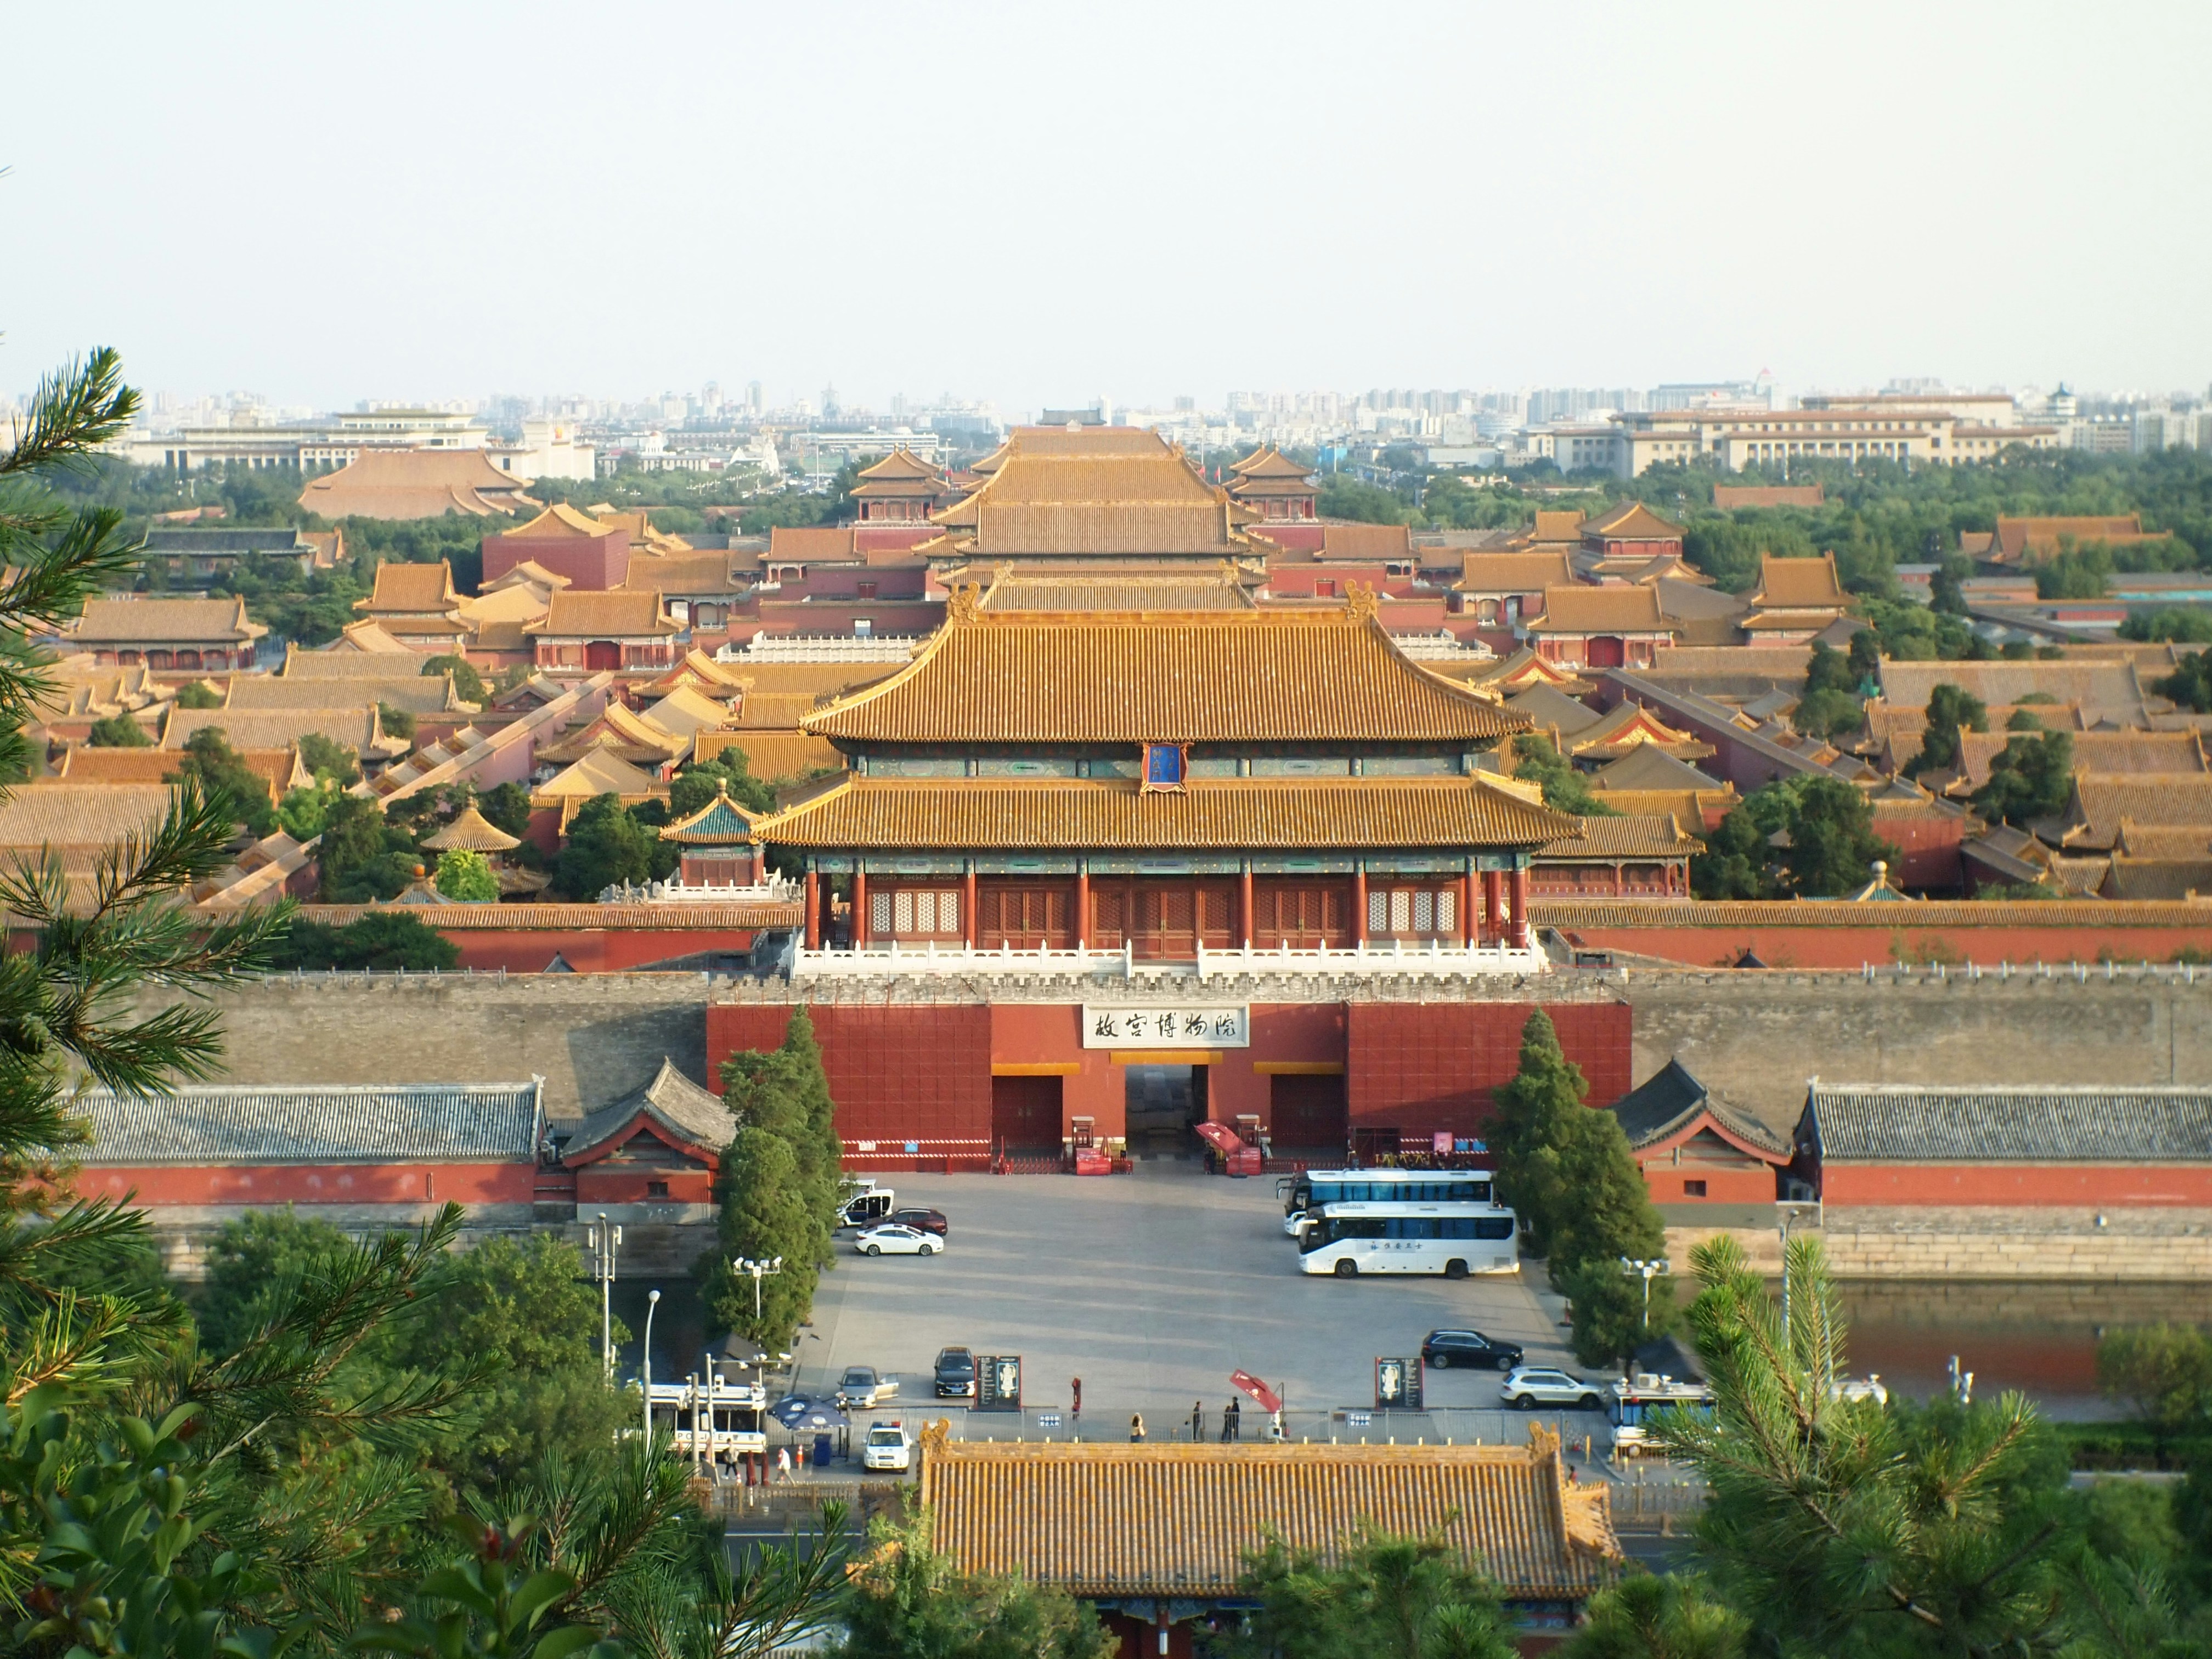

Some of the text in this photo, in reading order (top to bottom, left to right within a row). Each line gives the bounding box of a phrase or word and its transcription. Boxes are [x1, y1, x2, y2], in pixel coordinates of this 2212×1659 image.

[1095, 1012, 1236, 1038] 故宫博物院
